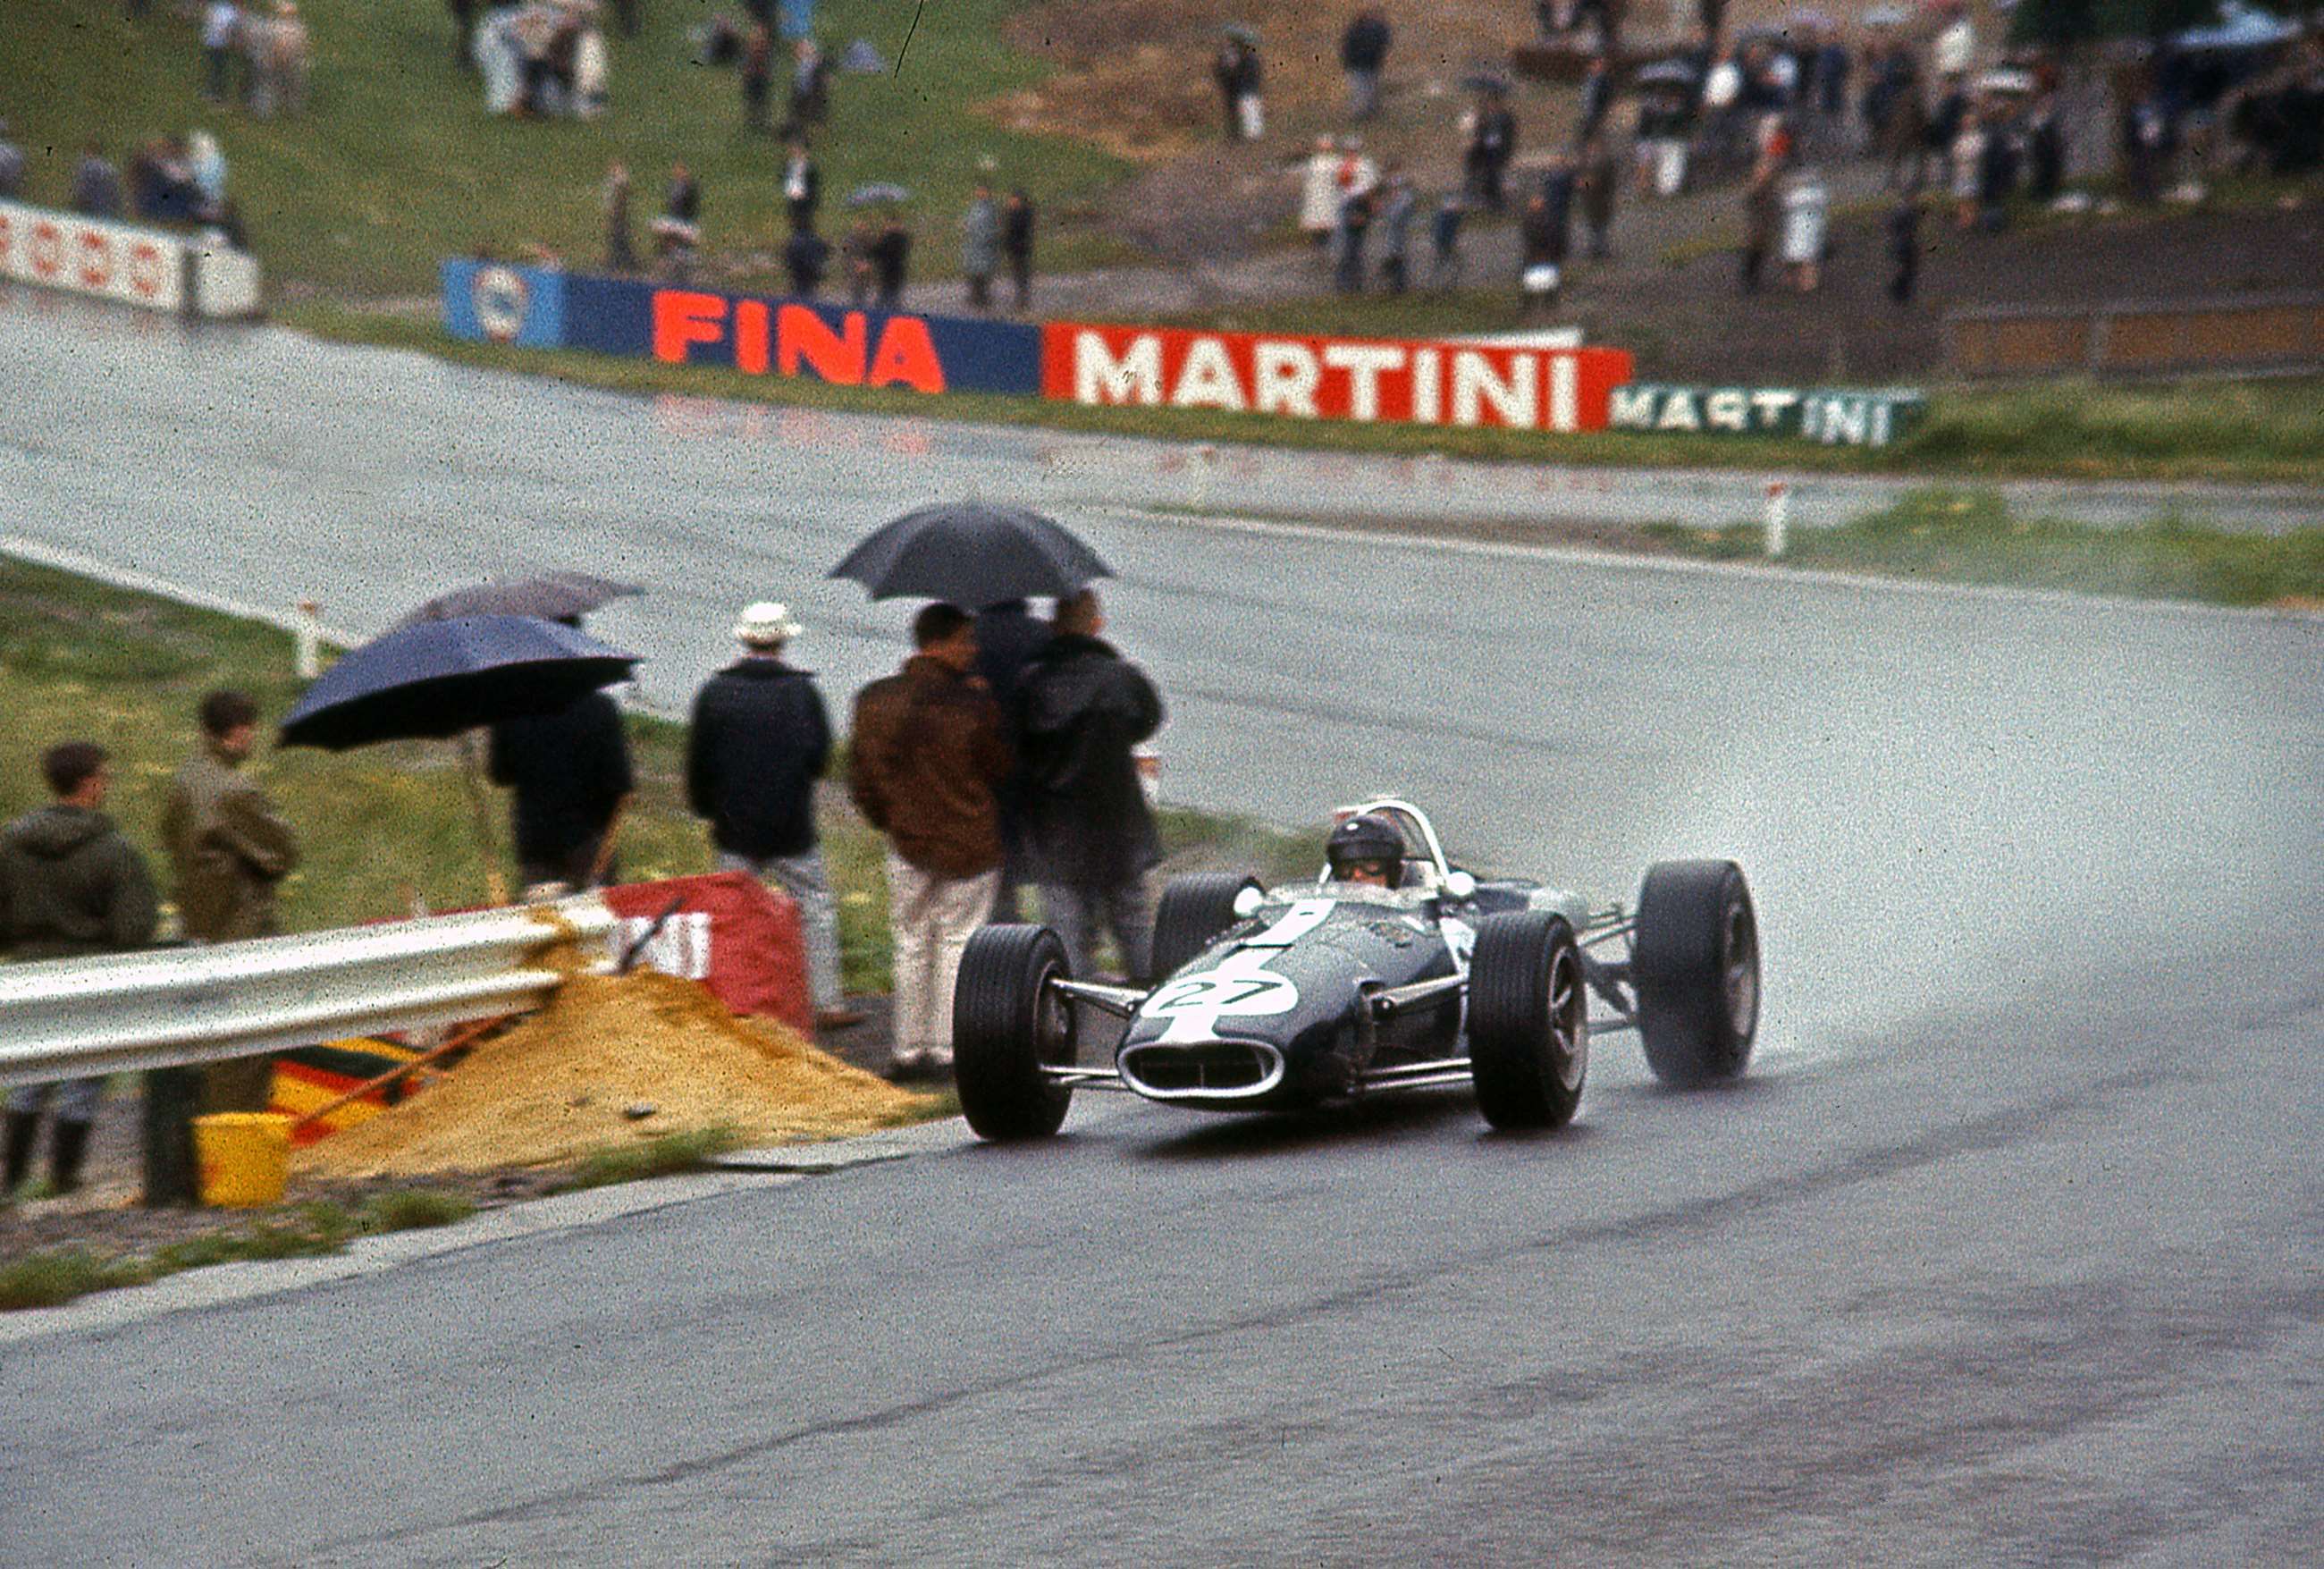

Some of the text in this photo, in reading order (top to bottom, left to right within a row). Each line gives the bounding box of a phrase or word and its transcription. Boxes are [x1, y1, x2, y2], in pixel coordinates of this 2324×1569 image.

[653, 290, 946, 393] FINA
[1074, 331, 1578, 433] MARTINI
[1610, 388, 1891, 446] MARTINI
[1158, 981, 1283, 1010] 27
